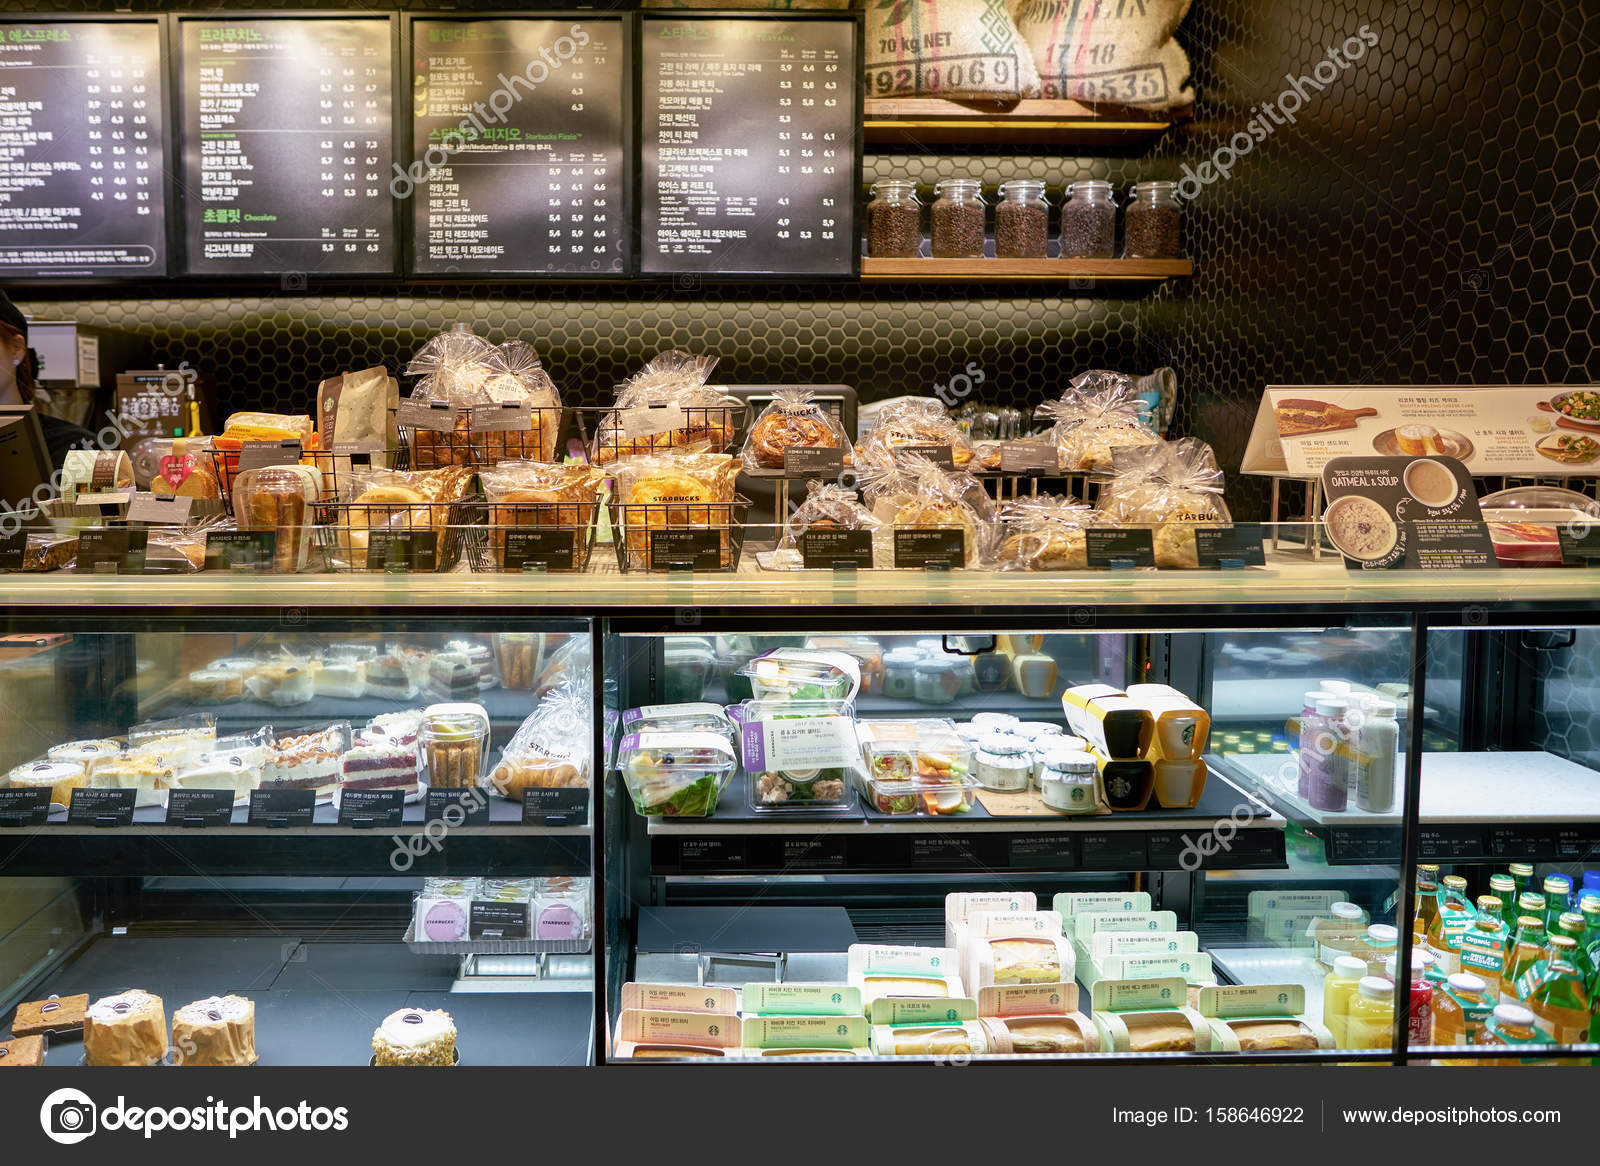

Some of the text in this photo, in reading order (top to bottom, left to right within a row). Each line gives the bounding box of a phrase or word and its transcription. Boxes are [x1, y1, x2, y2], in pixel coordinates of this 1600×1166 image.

[879, 32, 952, 53] 70 kg NET
[204, 209, 277, 223] 초콜릿 Chocolate
[1332, 477, 1370, 487] OATMEAL
[1378, 477, 1398, 486] SOUP
[1466, 936, 1491, 946] Organic
[1462, 955, 1499, 968] STARBUCKS
